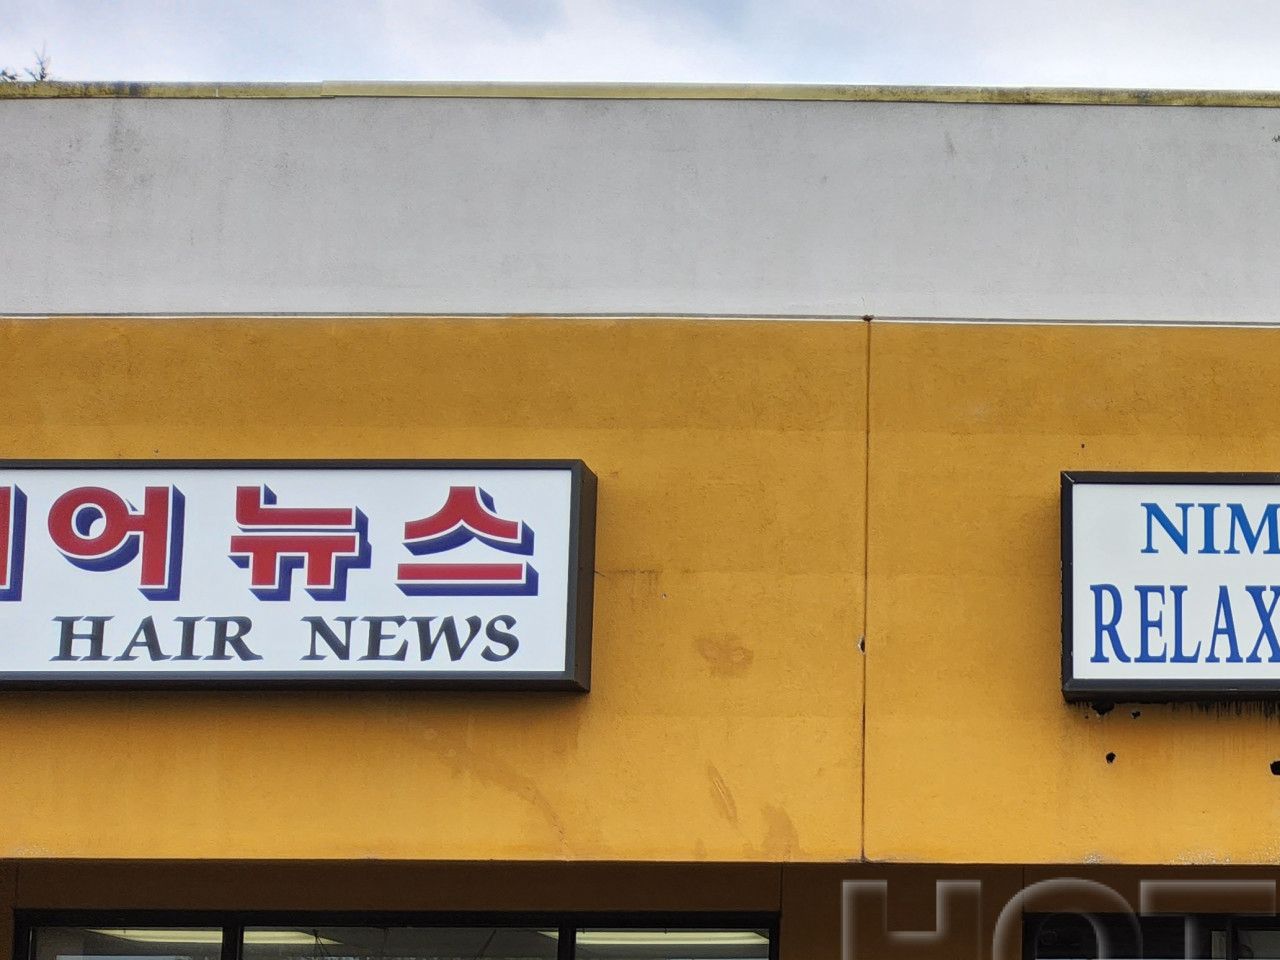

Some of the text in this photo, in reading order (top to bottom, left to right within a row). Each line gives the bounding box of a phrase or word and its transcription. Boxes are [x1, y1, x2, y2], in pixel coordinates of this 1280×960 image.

[0, 484, 538, 601] 어 뉴스
[50, 615, 520, 662] HAIR NEWS
